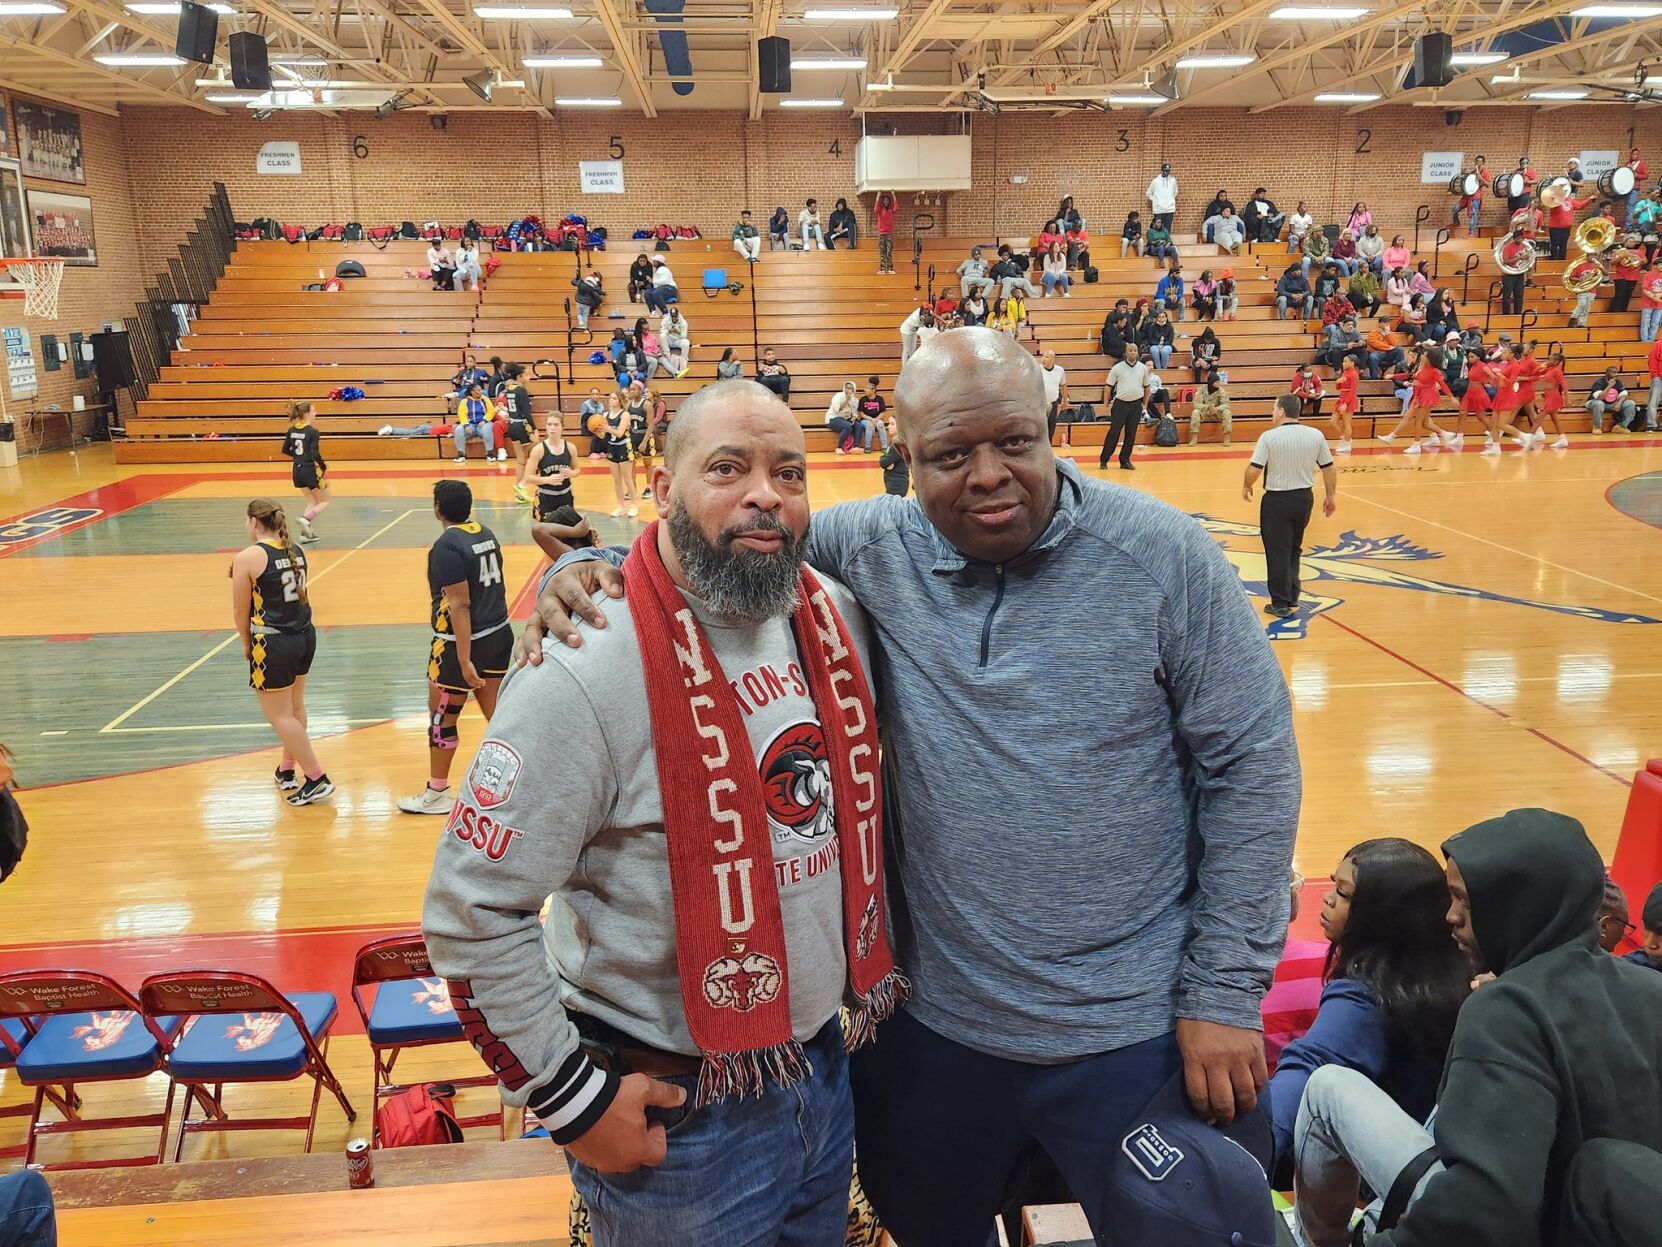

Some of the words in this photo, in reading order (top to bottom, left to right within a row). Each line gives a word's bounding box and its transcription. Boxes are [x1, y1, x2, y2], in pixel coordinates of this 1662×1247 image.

[354, 135, 369, 159] 6
[610, 136, 625, 160] 5
[828, 137, 842, 158] 4
[1115, 129, 1130, 152] 3
[1356, 129, 1371, 153] 2
[1627, 127, 1635, 149] 1
[294, 439, 304, 456] 3
[479, 552, 502, 588] 44
[404, 958, 429, 967] Bapti
[30, 986, 60, 995] Wake
[62, 983, 97, 993] Forest
[33, 993, 67, 1002] Baptist
[69, 989, 100, 998] Health
[186, 984, 215, 993] Wake
[223, 990, 253, 998] Health
